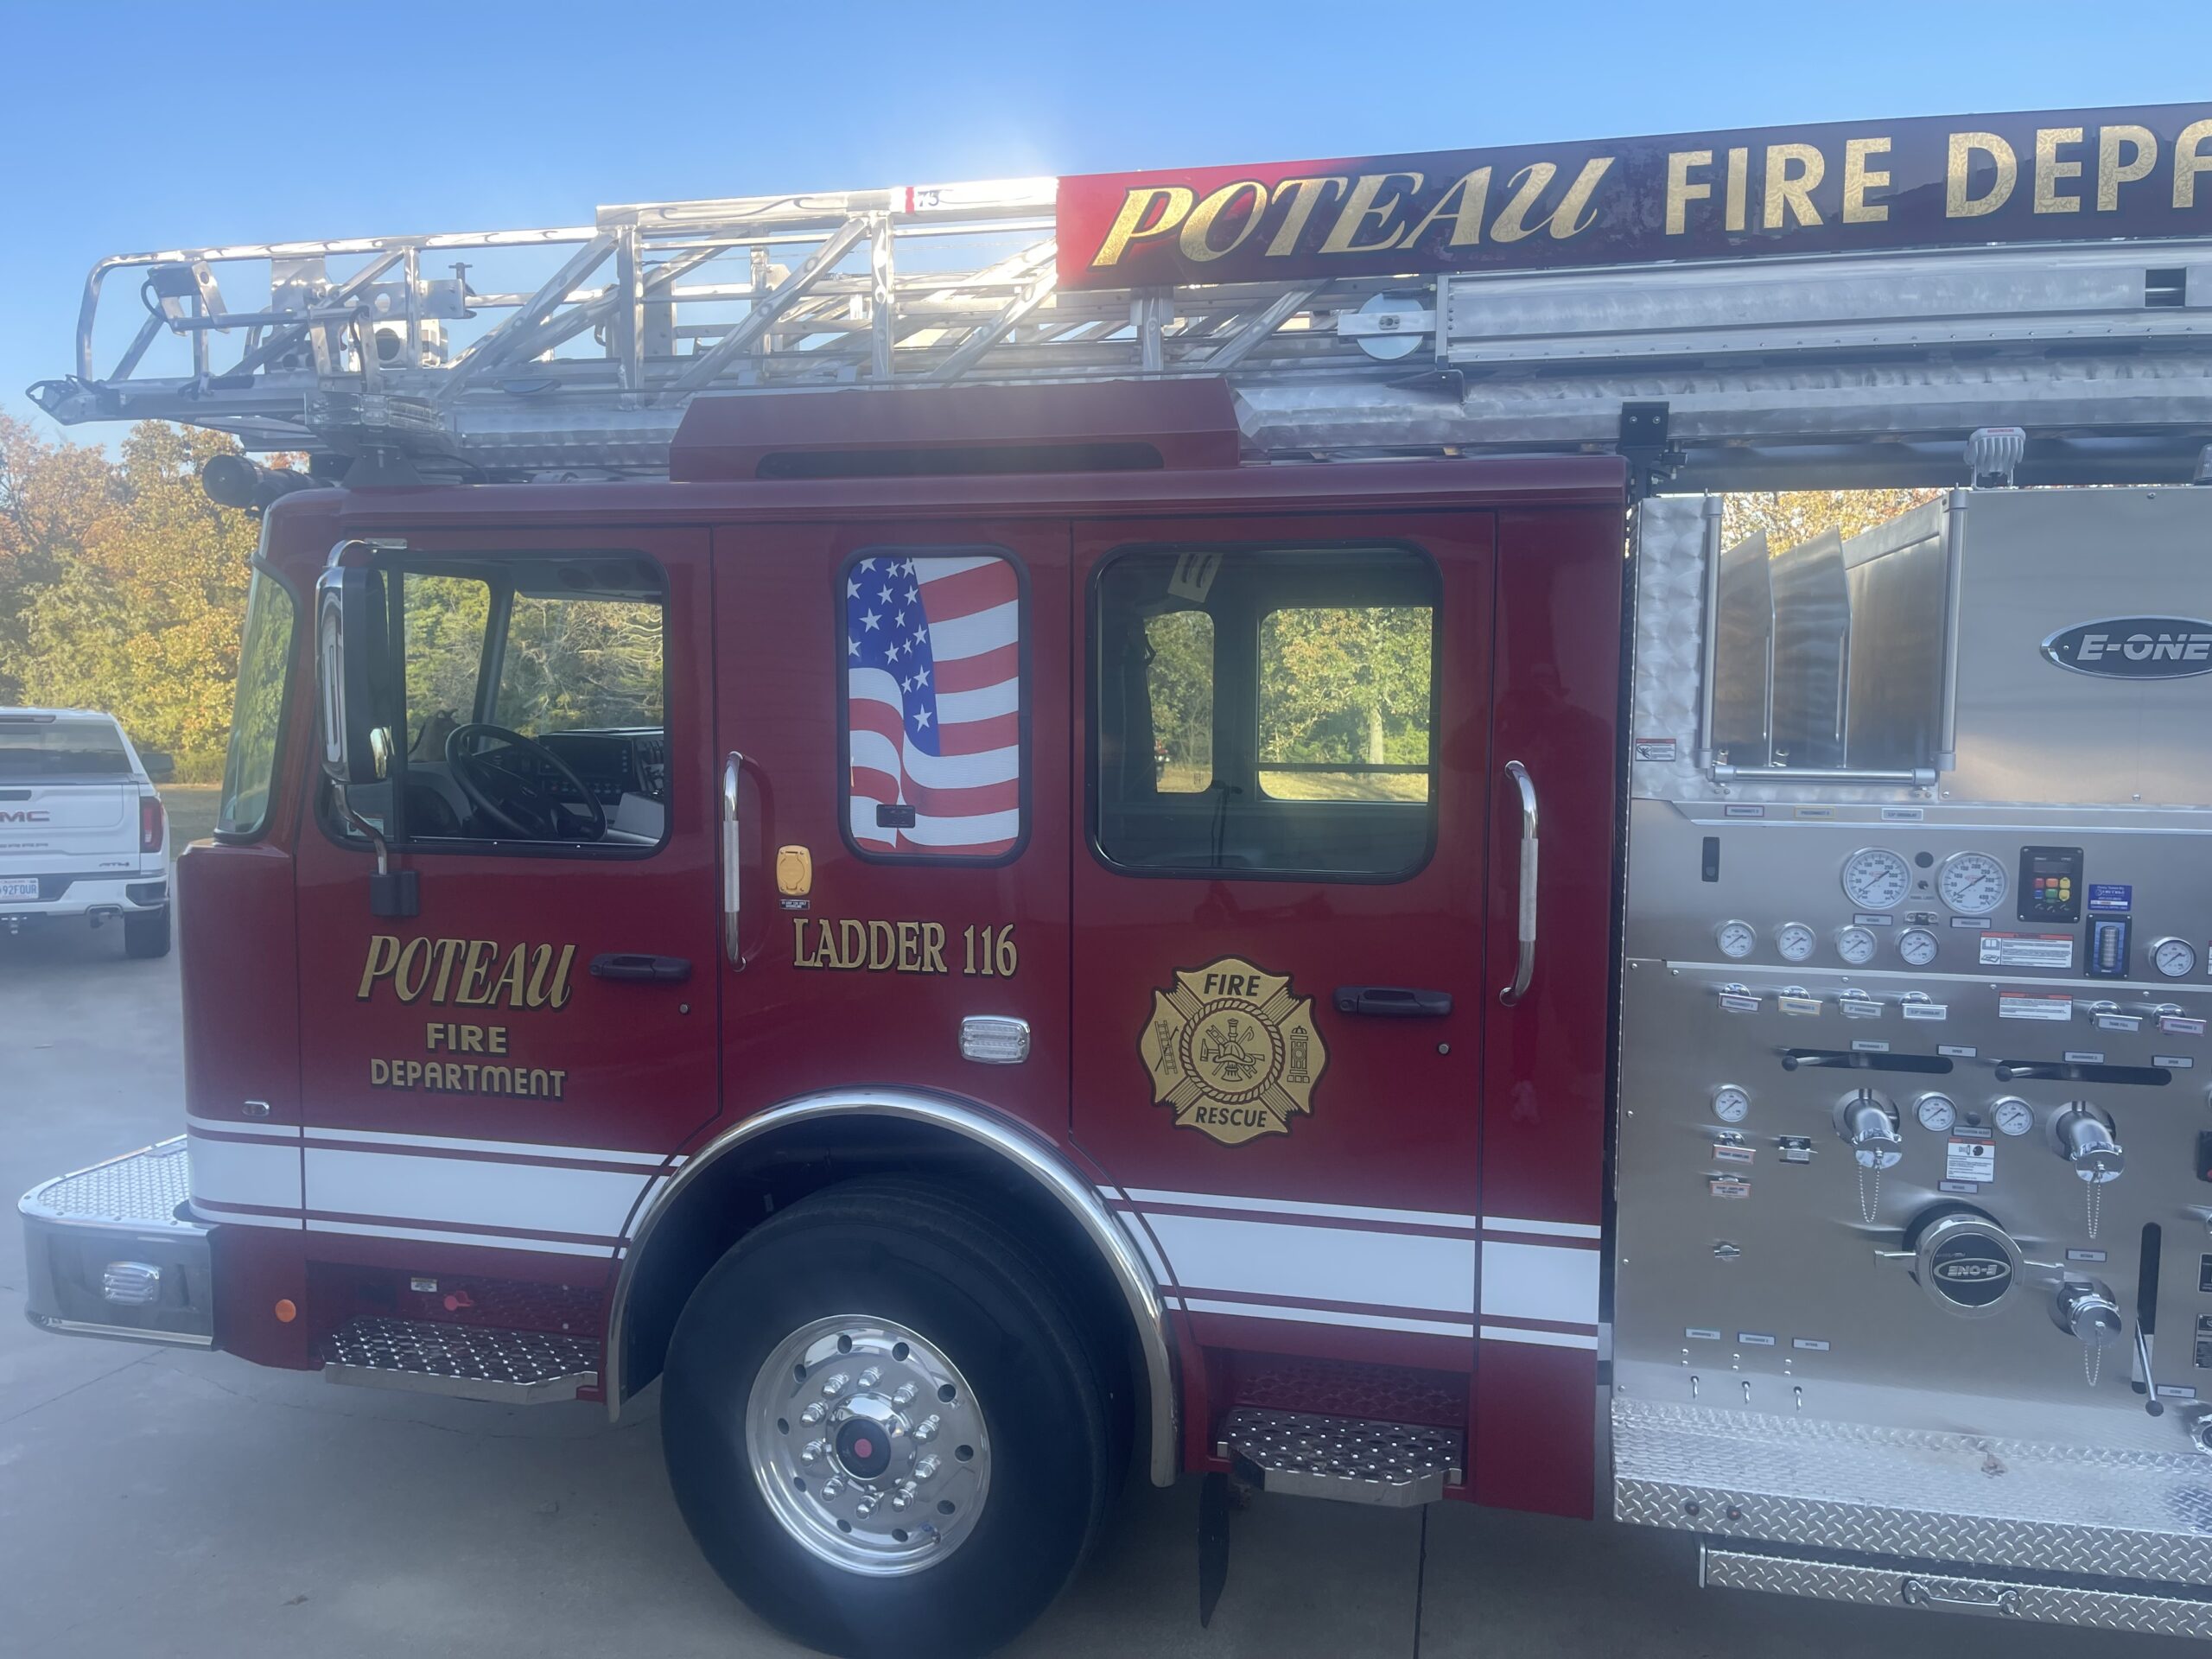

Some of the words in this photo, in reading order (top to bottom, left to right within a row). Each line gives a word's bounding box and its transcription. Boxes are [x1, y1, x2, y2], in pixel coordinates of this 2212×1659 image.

[917, 189, 939, 207] 75
[1091, 156, 1616, 267] POTEAU
[1665, 137, 1892, 236] FIRE
[2076, 633, 2212, 661] E-ONE
[793, 918, 947, 973] LADDER
[963, 924, 1017, 976] 116
[356, 935, 576, 1008] POTEAU
[1204, 973, 1261, 996] FIRE
[426, 1022, 508, 1053] FIRE
[370, 1058, 566, 1097] DEPARTMENT
[1195, 1106, 1268, 1128] RESCUE
